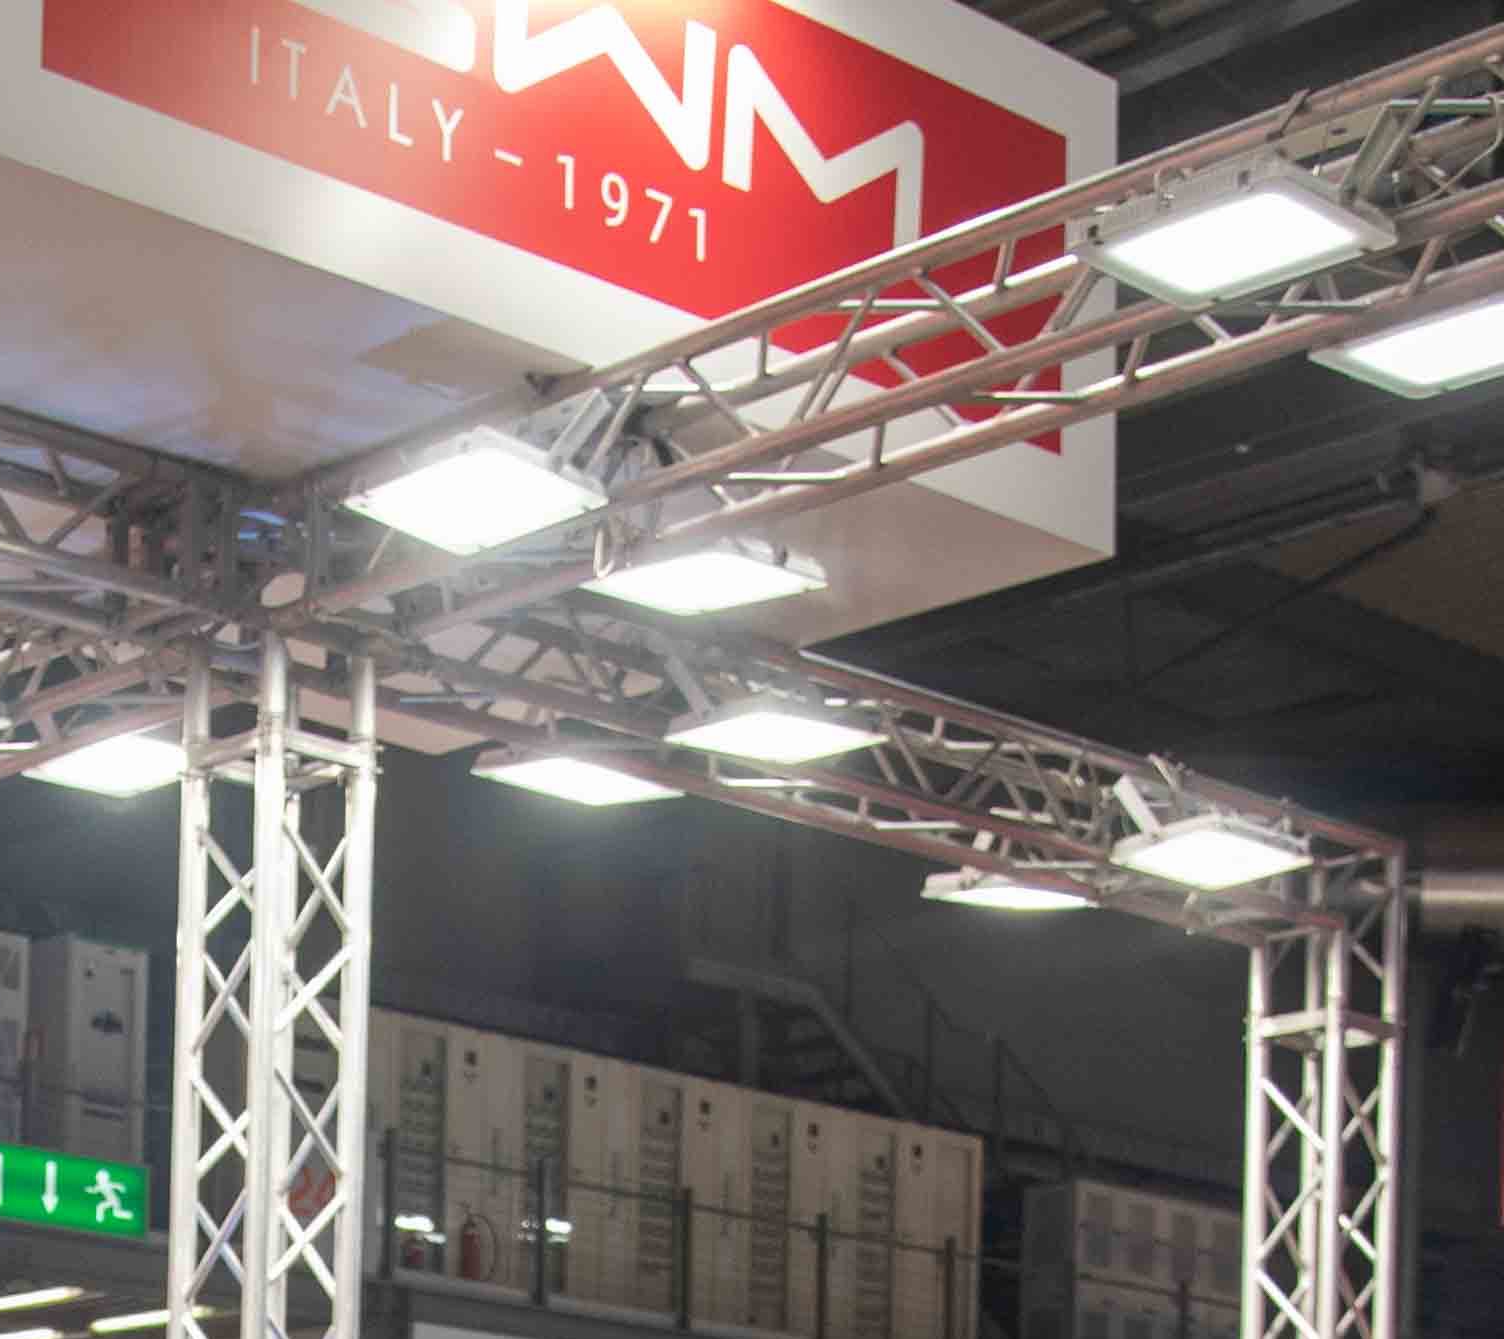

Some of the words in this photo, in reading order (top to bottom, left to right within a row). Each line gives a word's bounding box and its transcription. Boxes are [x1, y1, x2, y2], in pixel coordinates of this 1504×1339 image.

[249, 26, 464, 161] ITALY
[555, 154, 707, 262] 1971
[308, 0, 925, 253] WM
